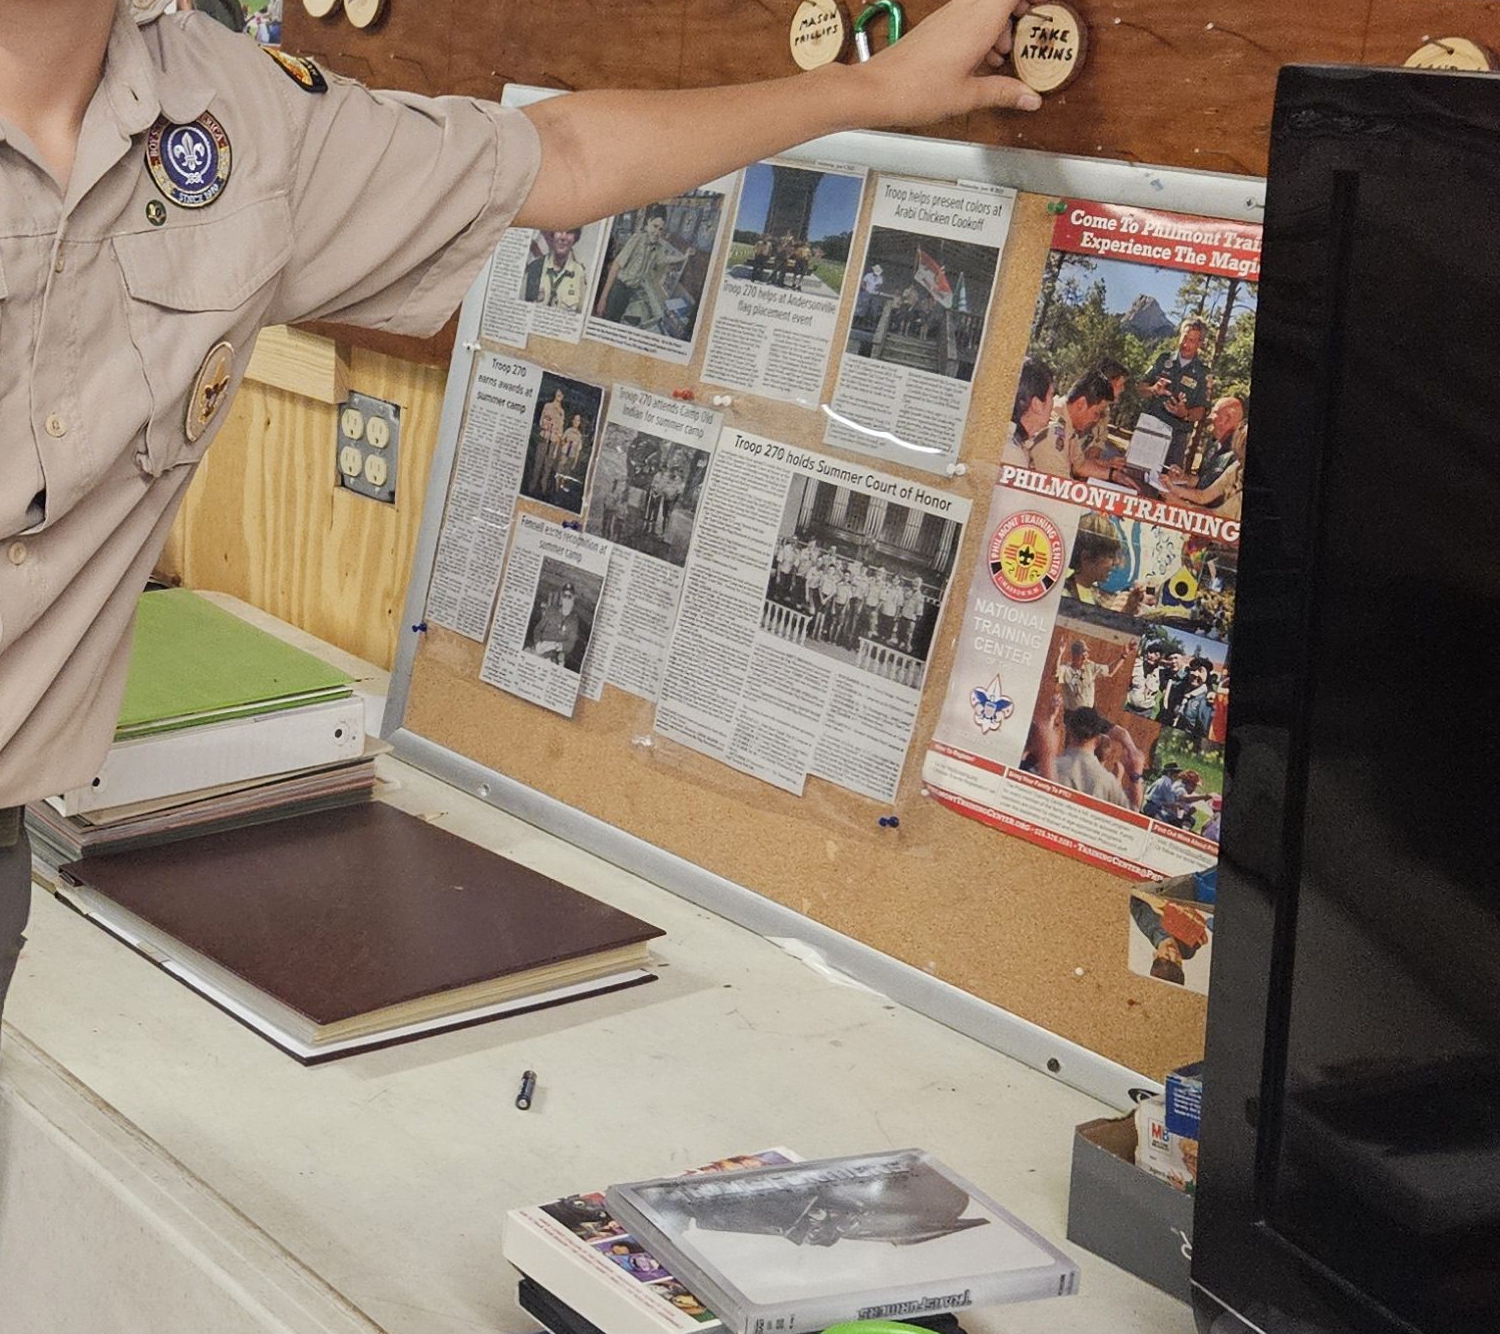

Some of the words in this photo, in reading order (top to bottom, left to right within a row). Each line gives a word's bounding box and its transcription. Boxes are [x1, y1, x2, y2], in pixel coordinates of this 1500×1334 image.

[799, 9, 838, 31] MASON
[1030, 25, 1070, 43] JAKE
[1020, 43, 1074, 61] ATKINS
[884, 184, 908, 203] Troop
[908, 191, 931, 207] helps
[931, 194, 964, 211] present
[964, 200, 992, 216] colors
[992, 205, 1003, 217] at
[893, 204, 917, 220] Arabi
[916, 208, 950, 225] Chicken
[950, 216, 984, 231] Cookoff
[1071, 210, 1117, 230] Come
[1120, 217, 1139, 234] To
[1141, 220, 1222, 246] Philmont
[1223, 231, 1263, 252] Trai
[1080, 232, 1172, 260] Experience
[1174, 245, 1207, 265] The
[722, 280, 743, 297] Troop
[742, 284, 758, 297] 270
[757, 287, 778, 303] helps
[787, 291, 837, 315] Andersonville
[751, 305, 792, 323] placement
[792, 313, 813, 326] event
[492, 358, 512, 375] Troop
[512, 364, 526, 378] 270
[478, 375, 497, 388] earns
[497, 378, 524, 395] awards
[477, 391, 505, 407] summer
[506, 399, 526, 414] camp
[734, 434, 764, 456] Troop
[763, 444, 784, 460] 270
[785, 449, 816, 470] holds
[816, 460, 864, 486] Summer
[864, 474, 897, 497] Court
[899, 486, 913, 499] of
[914, 489, 952, 512] Honor
[999, 465, 1121, 514] PHILMONT
[1122, 497, 1241, 542] TRAINING
[539, 539, 564, 554] summer
[565, 548, 583, 563] camp
[990, 518, 1018, 559] PHILMONT
[1020, 514, 1055, 540] TRAINING
[1050, 534, 1064, 576] CENTER
[974, 598, 1047, 633] NATIONAL
[973, 616, 1044, 649] TRAINING
[974, 636, 1033, 665] CENTER
